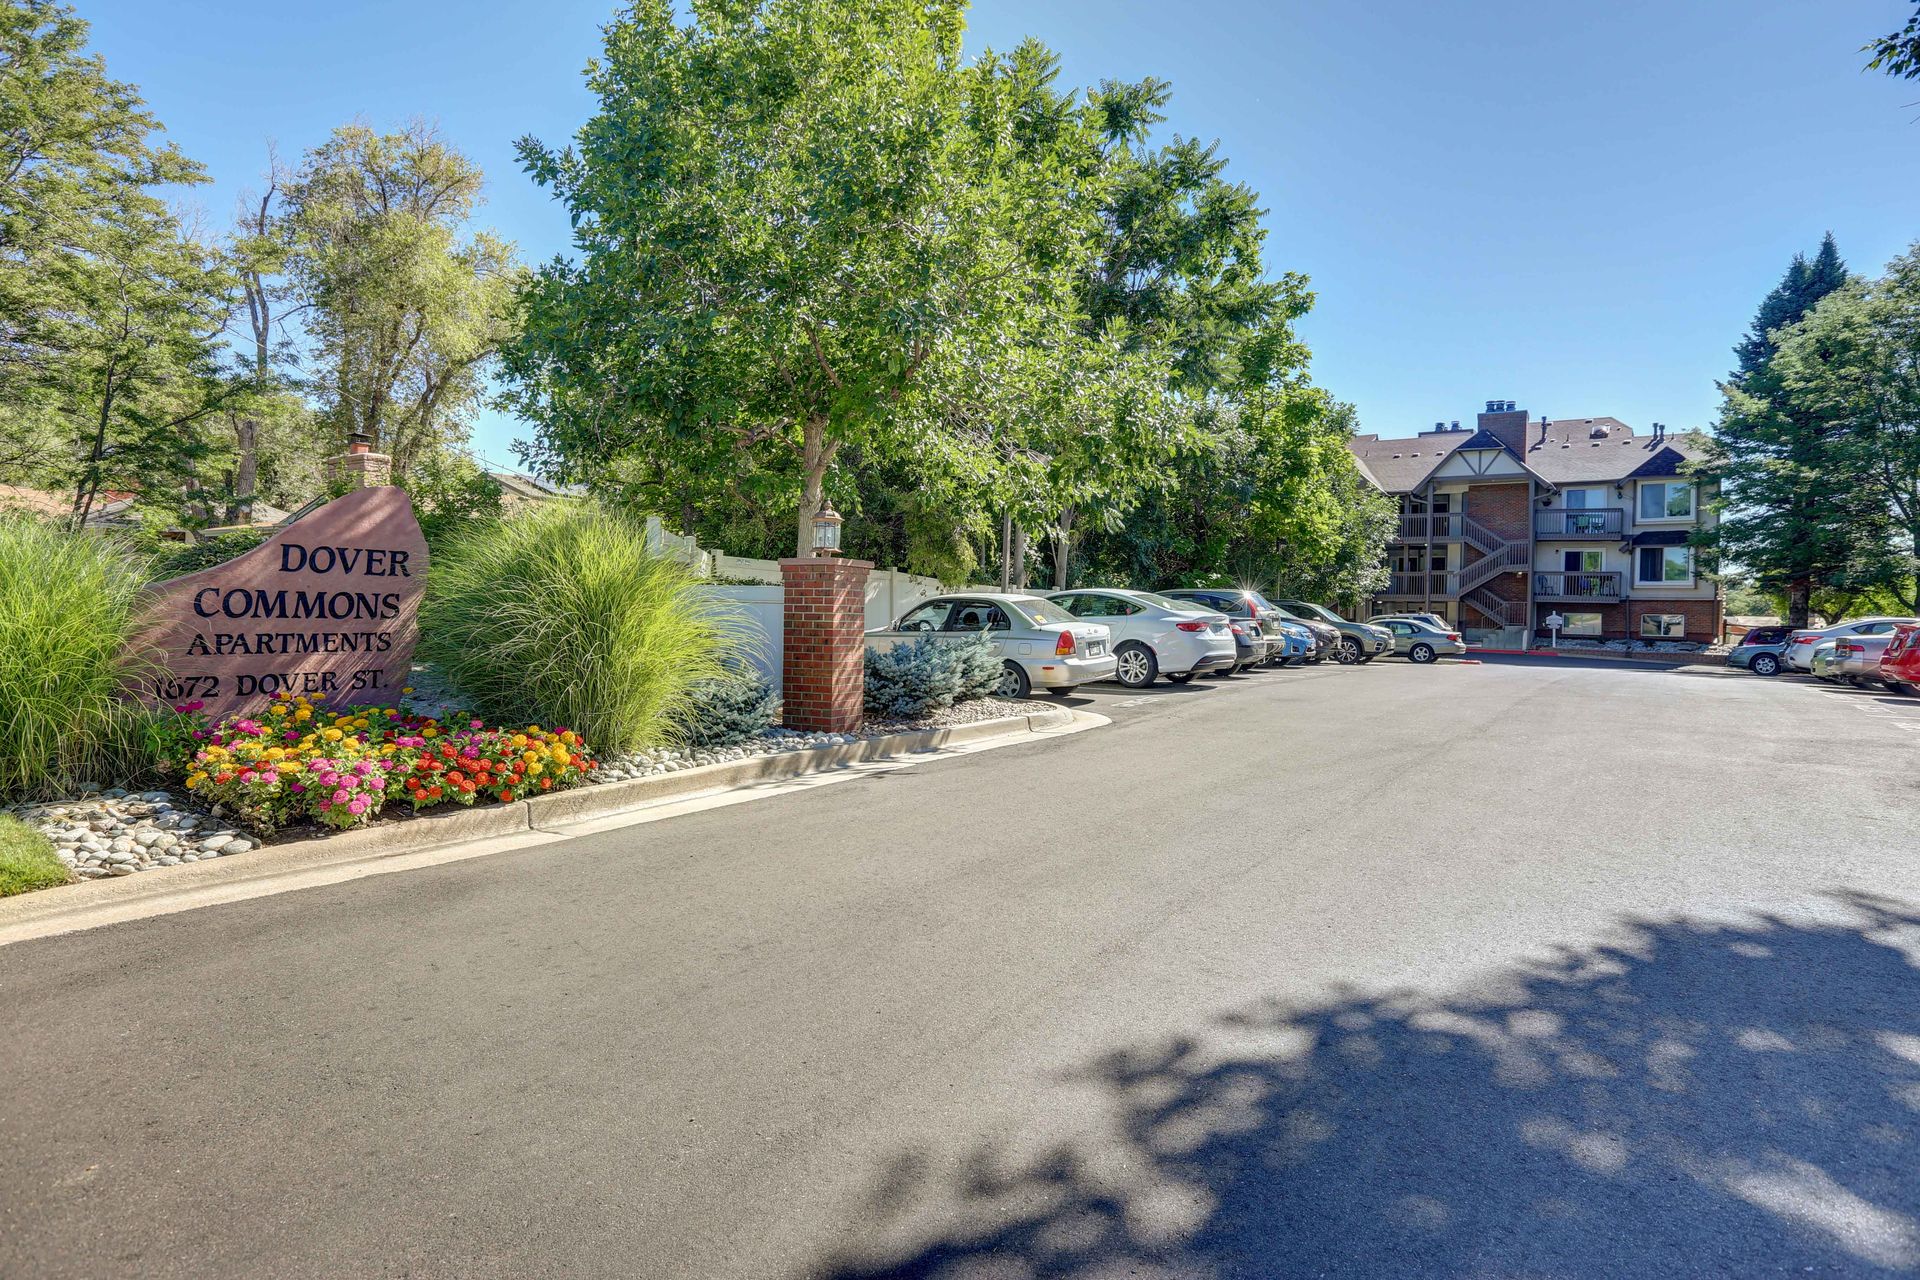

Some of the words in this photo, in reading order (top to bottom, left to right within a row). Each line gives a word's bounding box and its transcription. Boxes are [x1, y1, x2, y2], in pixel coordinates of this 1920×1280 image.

[279, 543, 411, 577] DOVER
[193, 587, 400, 620] COMMONS
[186, 632, 392, 656] APARTMENTS
[153, 675, 220, 700] 1672
[236, 671, 339, 697] DOVER
[351, 669, 389, 690] ST.
